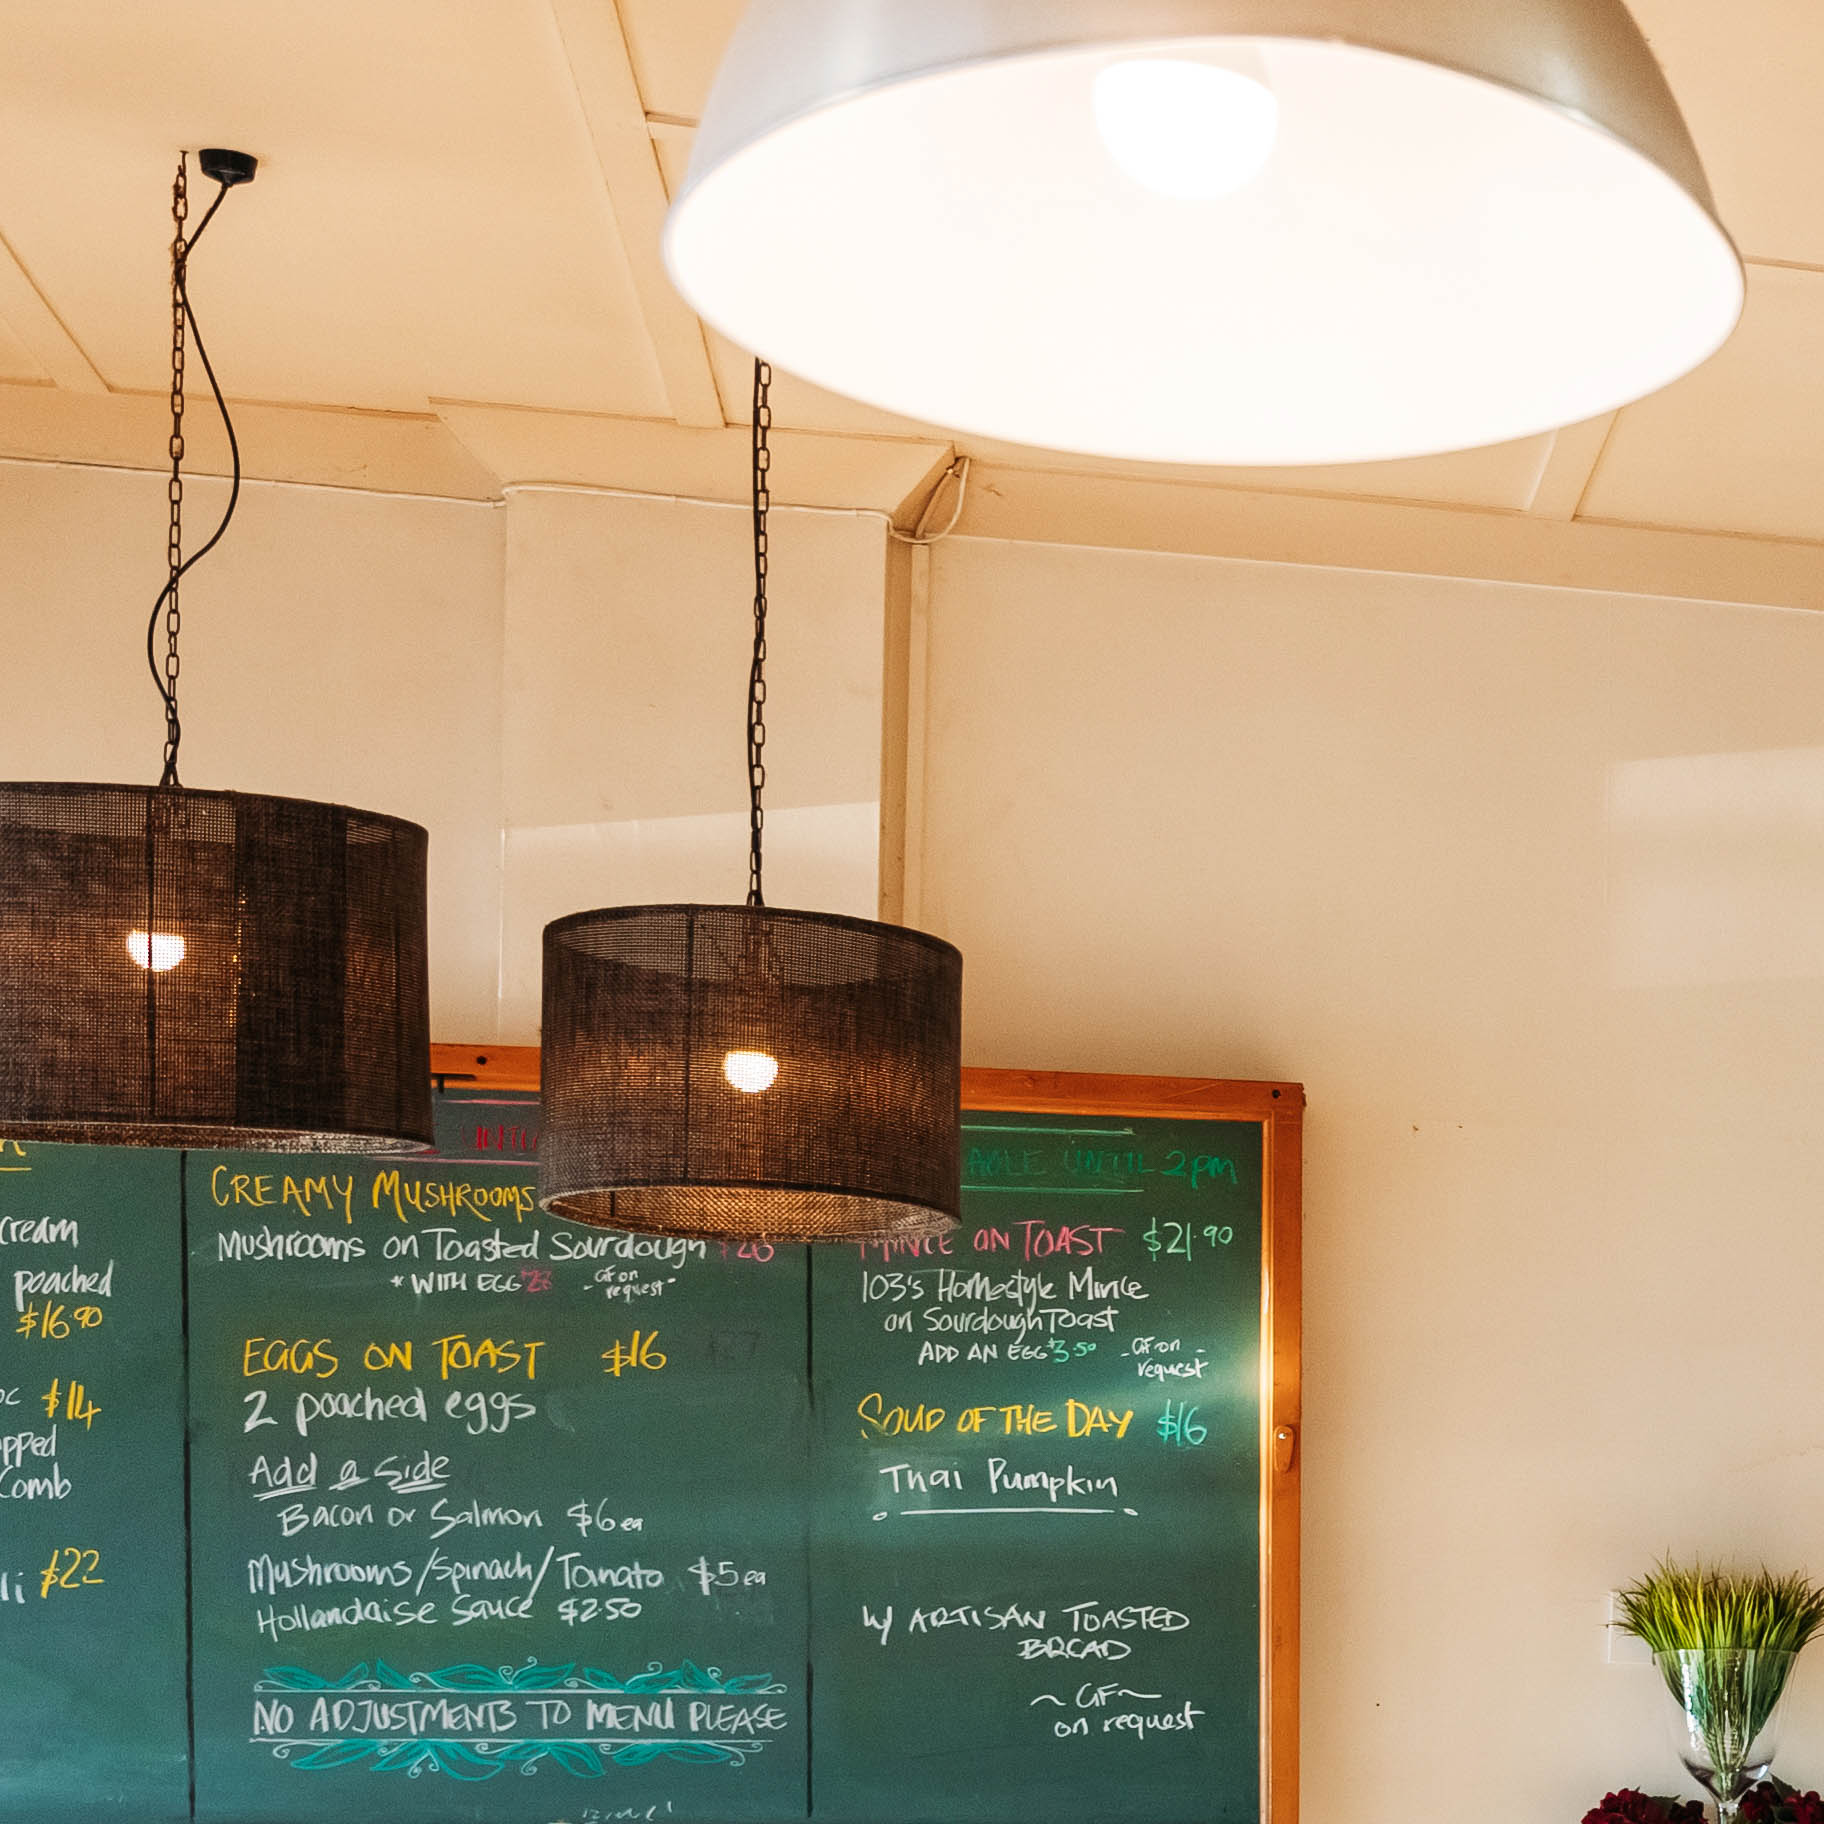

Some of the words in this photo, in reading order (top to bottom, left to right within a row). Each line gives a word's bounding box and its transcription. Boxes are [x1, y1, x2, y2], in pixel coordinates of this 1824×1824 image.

[212, 1166, 353, 1224] CREAMY
[373, 1169, 536, 1224] MUSHROOMS
[219, 1229, 365, 1262] Mushrooms
[384, 1235, 418, 1262] on
[420, 1228, 539, 1263] Toasted
[549, 1231, 706, 1268] Sourdough
[975, 1227, 1010, 1252] ON
[1012, 1220, 1126, 1262] TOAST
[1143, 1217, 1233, 1262] $21.90
[14, 1259, 113, 1312] poached
[412, 1273, 467, 1293] WITH
[478, 1275, 522, 1292] EGG
[862, 1270, 924, 1303] 103's
[1069, 1267, 1149, 1301] Mince
[927, 1307, 1041, 1344] Sourdough
[1041, 1307, 1118, 1333] Toast
[243, 1338, 337, 1378] EGGS
[365, 1341, 411, 1373] ON
[433, 1334, 545, 1379] TOAST
[601, 1332, 667, 1376] $16
[919, 1344, 956, 1365] ADD
[1008, 1345, 1048, 1360] EGG
[42, 1378, 101, 1431] $14
[243, 1391, 276, 1433] 2
[298, 1388, 426, 1437] poached
[446, 1392, 535, 1434] eggs
[958, 1406, 995, 1433] OF
[999, 1405, 1057, 1433] THE
[1067, 1400, 1133, 1439] DAY
[1157, 1400, 1208, 1446] $16
[250, 1453, 316, 1490] Add
[376, 1452, 450, 1486] Side
[880, 1462, 962, 1496] Thai
[989, 1458, 1118, 1502] Pumpkin
[279, 1502, 373, 1536] Bacon
[388, 1505, 416, 1526] or
[430, 1500, 543, 1538] Salmon
[40, 1548, 104, 1599] $22
[258, 1598, 436, 1641] Hollandaise
[910, 1604, 1045, 1631] ARTISAN
[1062, 1601, 1190, 1632] TOASTED
[255, 1699, 294, 1734] NO
[310, 1699, 516, 1734] ADJUSTMENTS
[527, 1699, 570, 1725] TO
[587, 1700, 674, 1733] MENU
[690, 1702, 787, 1733] PLEASE
[1103, 1702, 1204, 1739] request
